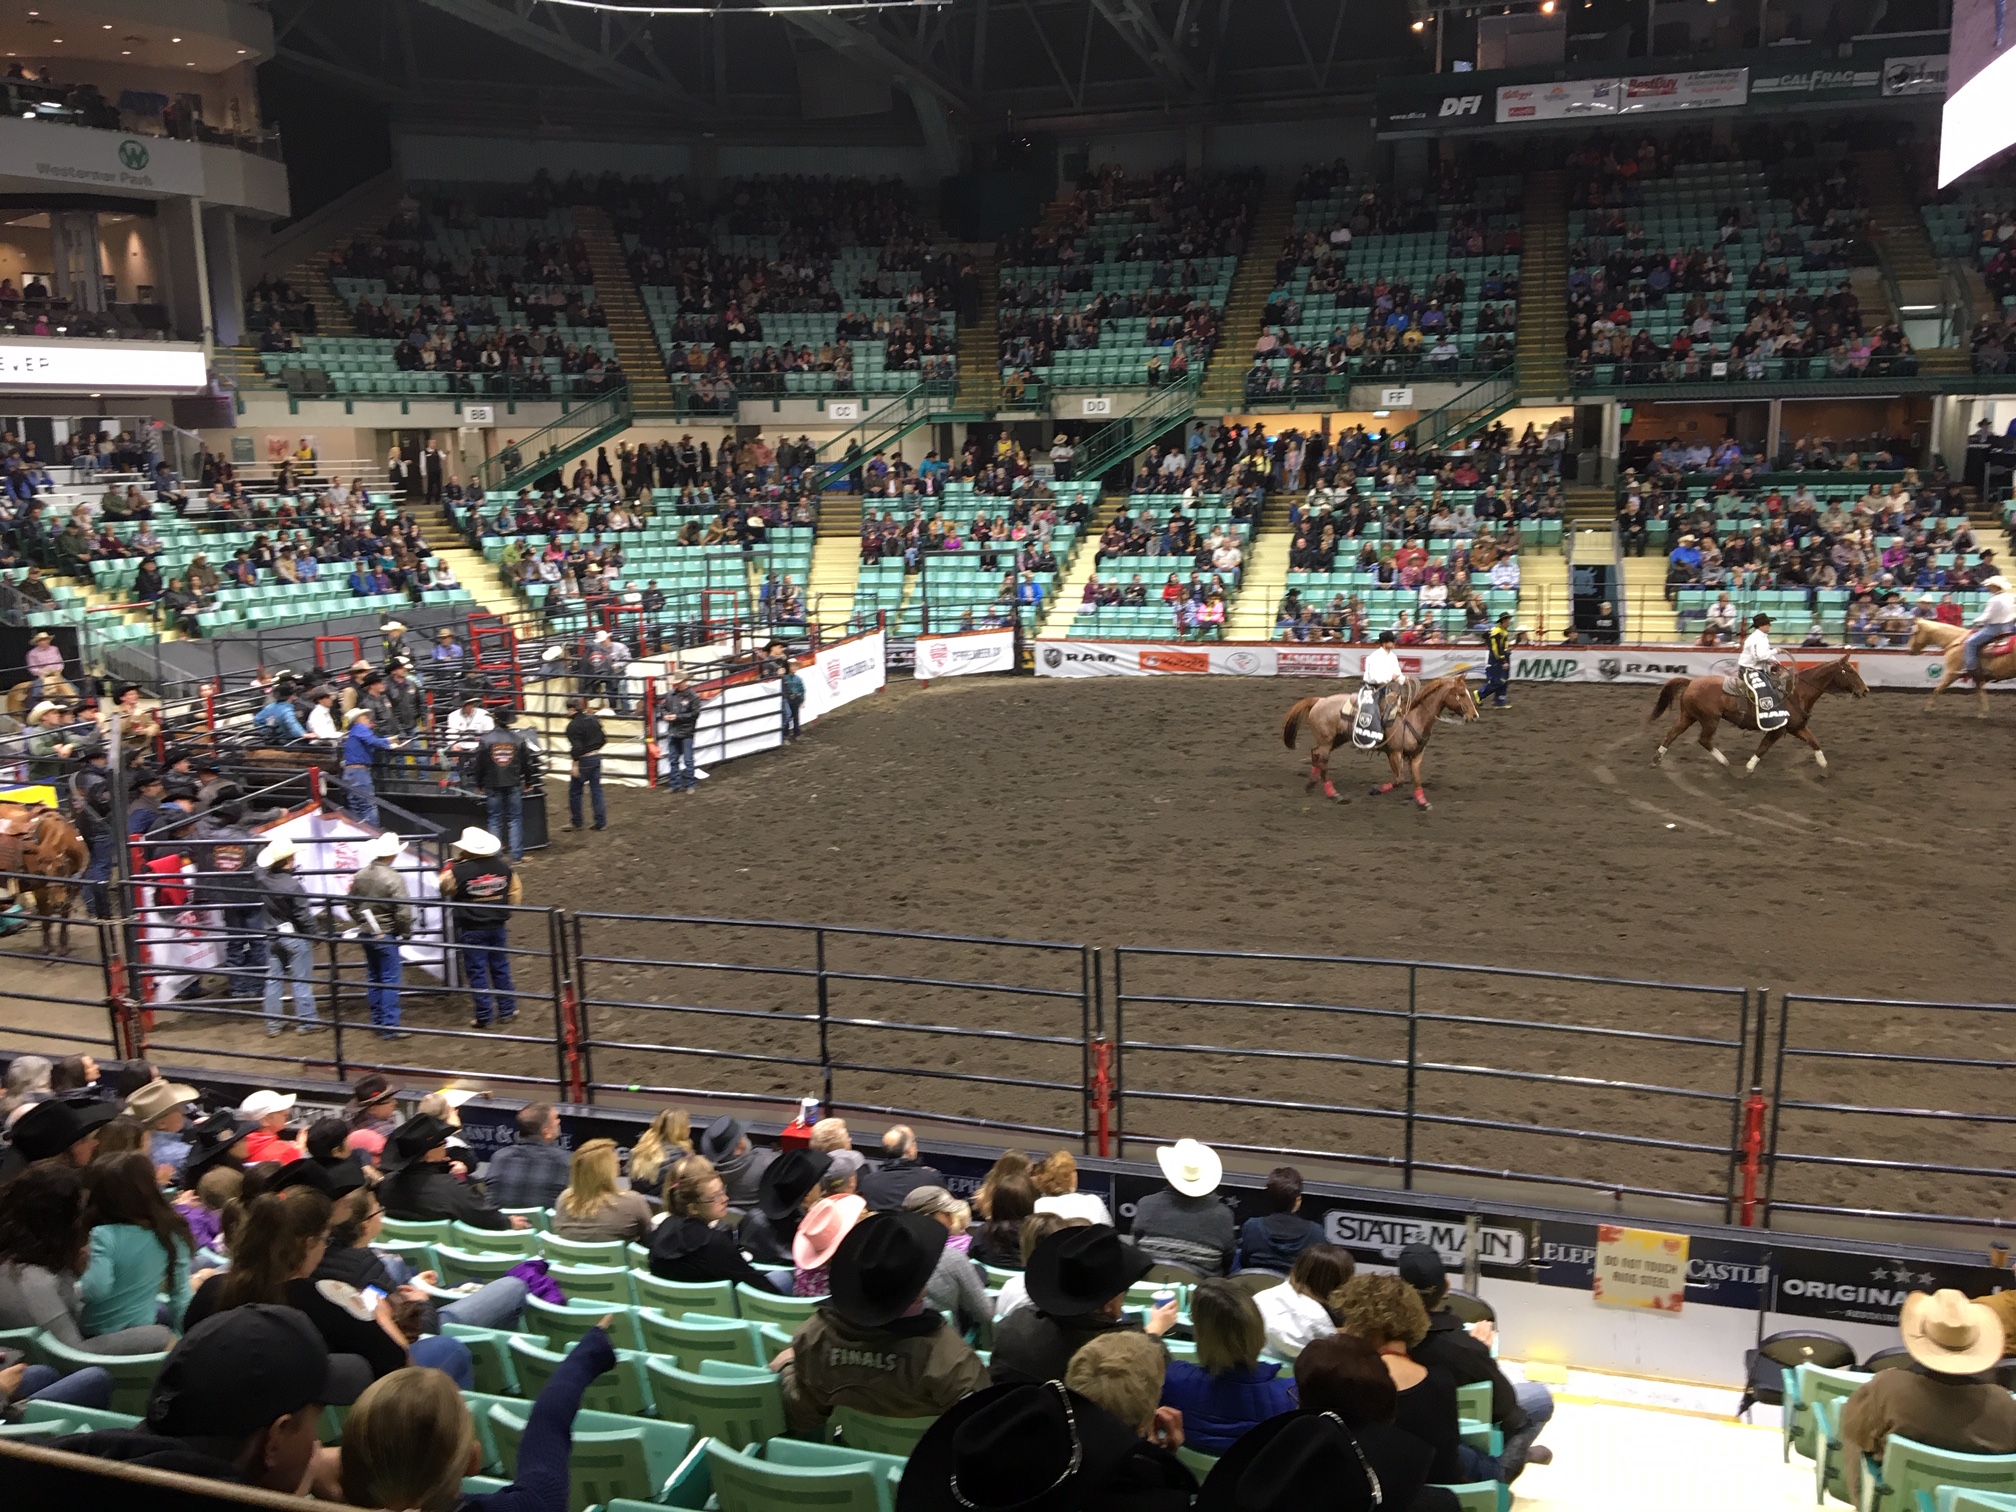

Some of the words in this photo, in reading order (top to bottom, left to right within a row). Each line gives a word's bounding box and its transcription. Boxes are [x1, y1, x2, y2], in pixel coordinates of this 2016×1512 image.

[1780, 70, 1854, 92] CALFRAC
[1438, 95, 1483, 117] DFI
[1388, 391, 1406, 403] FF
[1086, 400, 1106, 412] DD
[470, 409, 488, 420] BB
[1065, 653, 1118, 663] RAM
[1516, 658, 1578, 679] MNP
[1626, 663, 1689, 674] RAM
[1759, 710, 1791, 719] RAM
[1782, 1278, 1909, 1307] ORIGINA
[830, 1347, 898, 1372] FINALS
